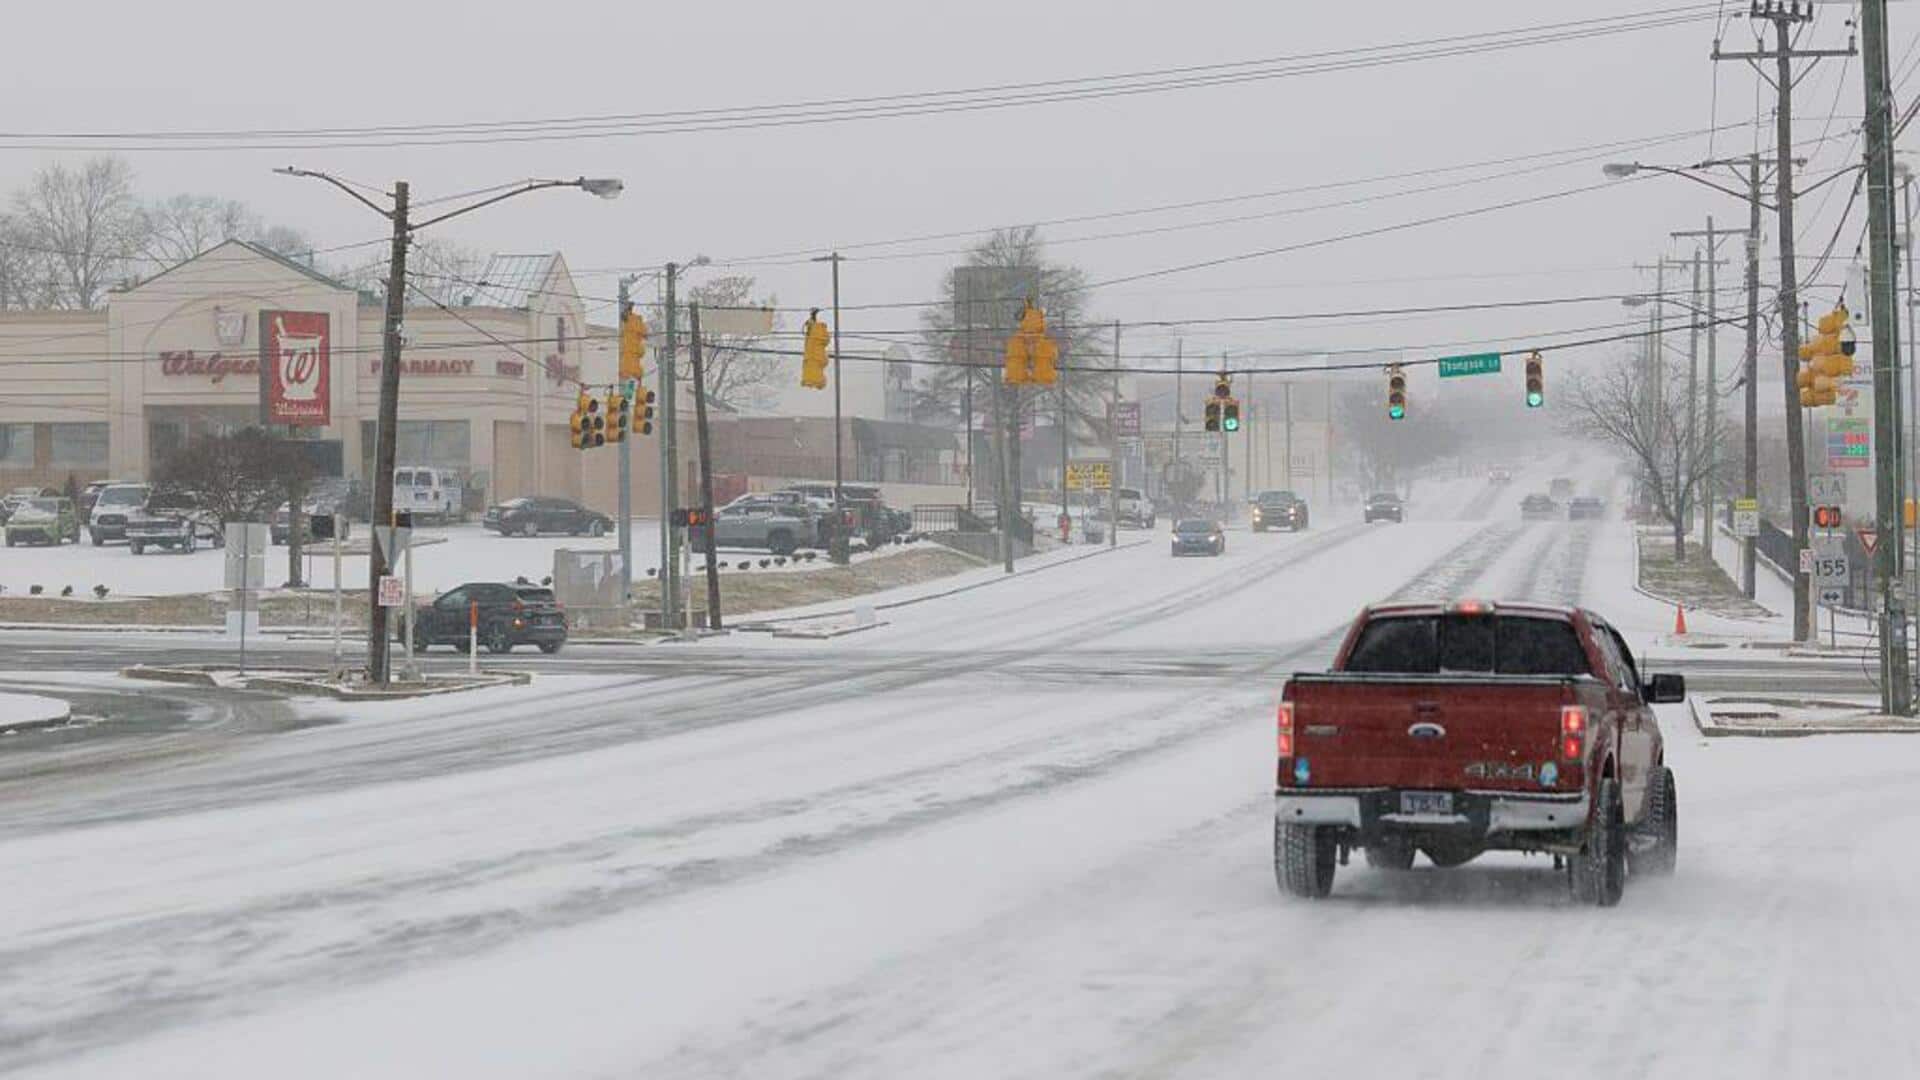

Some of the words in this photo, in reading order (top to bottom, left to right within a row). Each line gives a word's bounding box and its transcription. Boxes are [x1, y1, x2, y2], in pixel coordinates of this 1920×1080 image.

[283, 347, 317, 384] W
[371, 359, 474, 374] PARMACY
[1440, 360, 1484, 374] Thompson
[275, 402, 324, 418] Walgreens
[1815, 559, 1846, 577] 155
